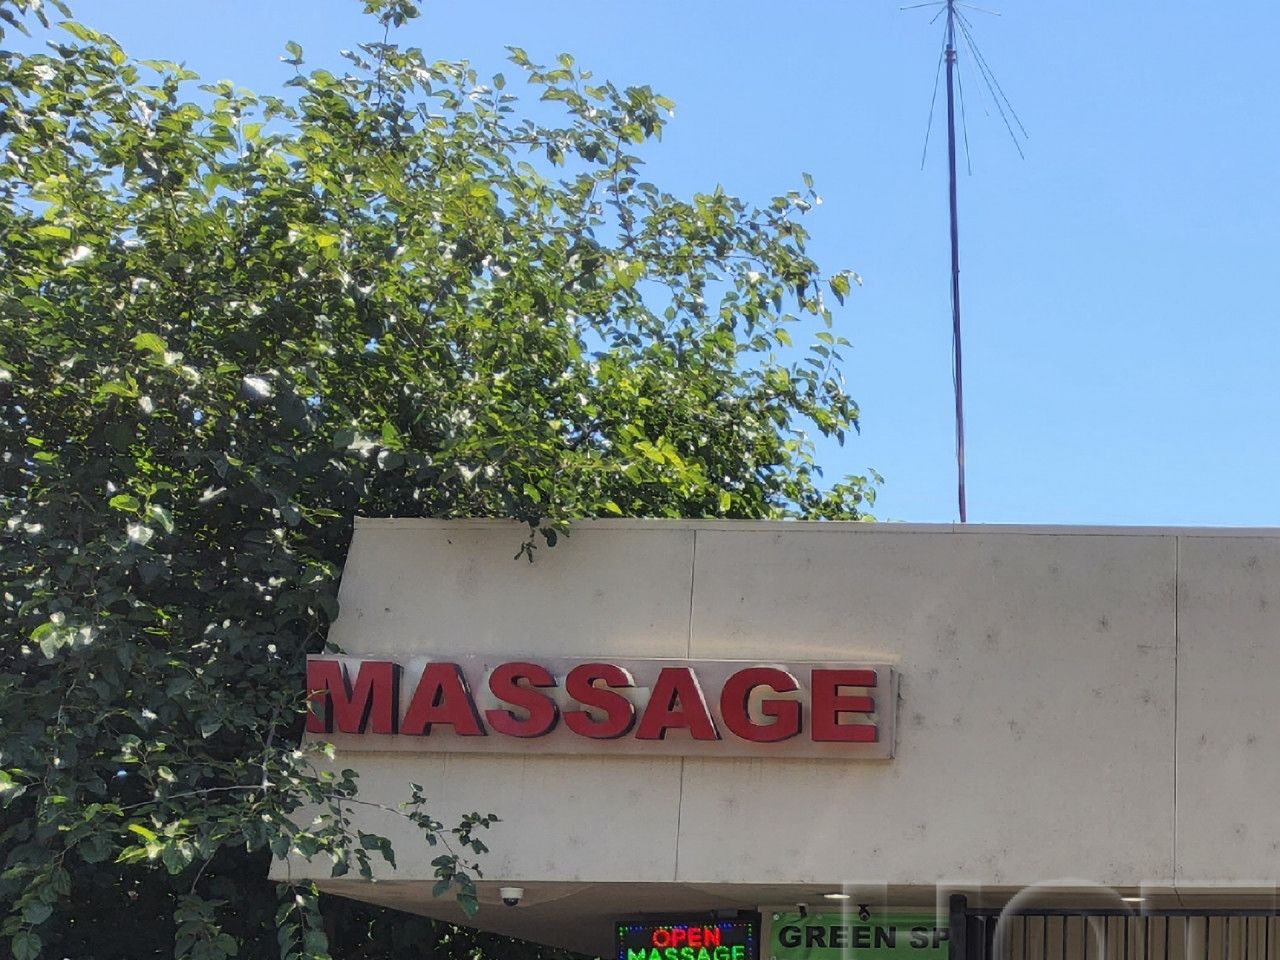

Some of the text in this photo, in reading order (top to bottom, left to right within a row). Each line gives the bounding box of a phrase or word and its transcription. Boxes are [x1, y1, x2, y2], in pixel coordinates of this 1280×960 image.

[306, 659, 880, 743] MASSAGE
[652, 927, 721, 948] OPEN
[778, 925, 950, 949] GREEN SP
